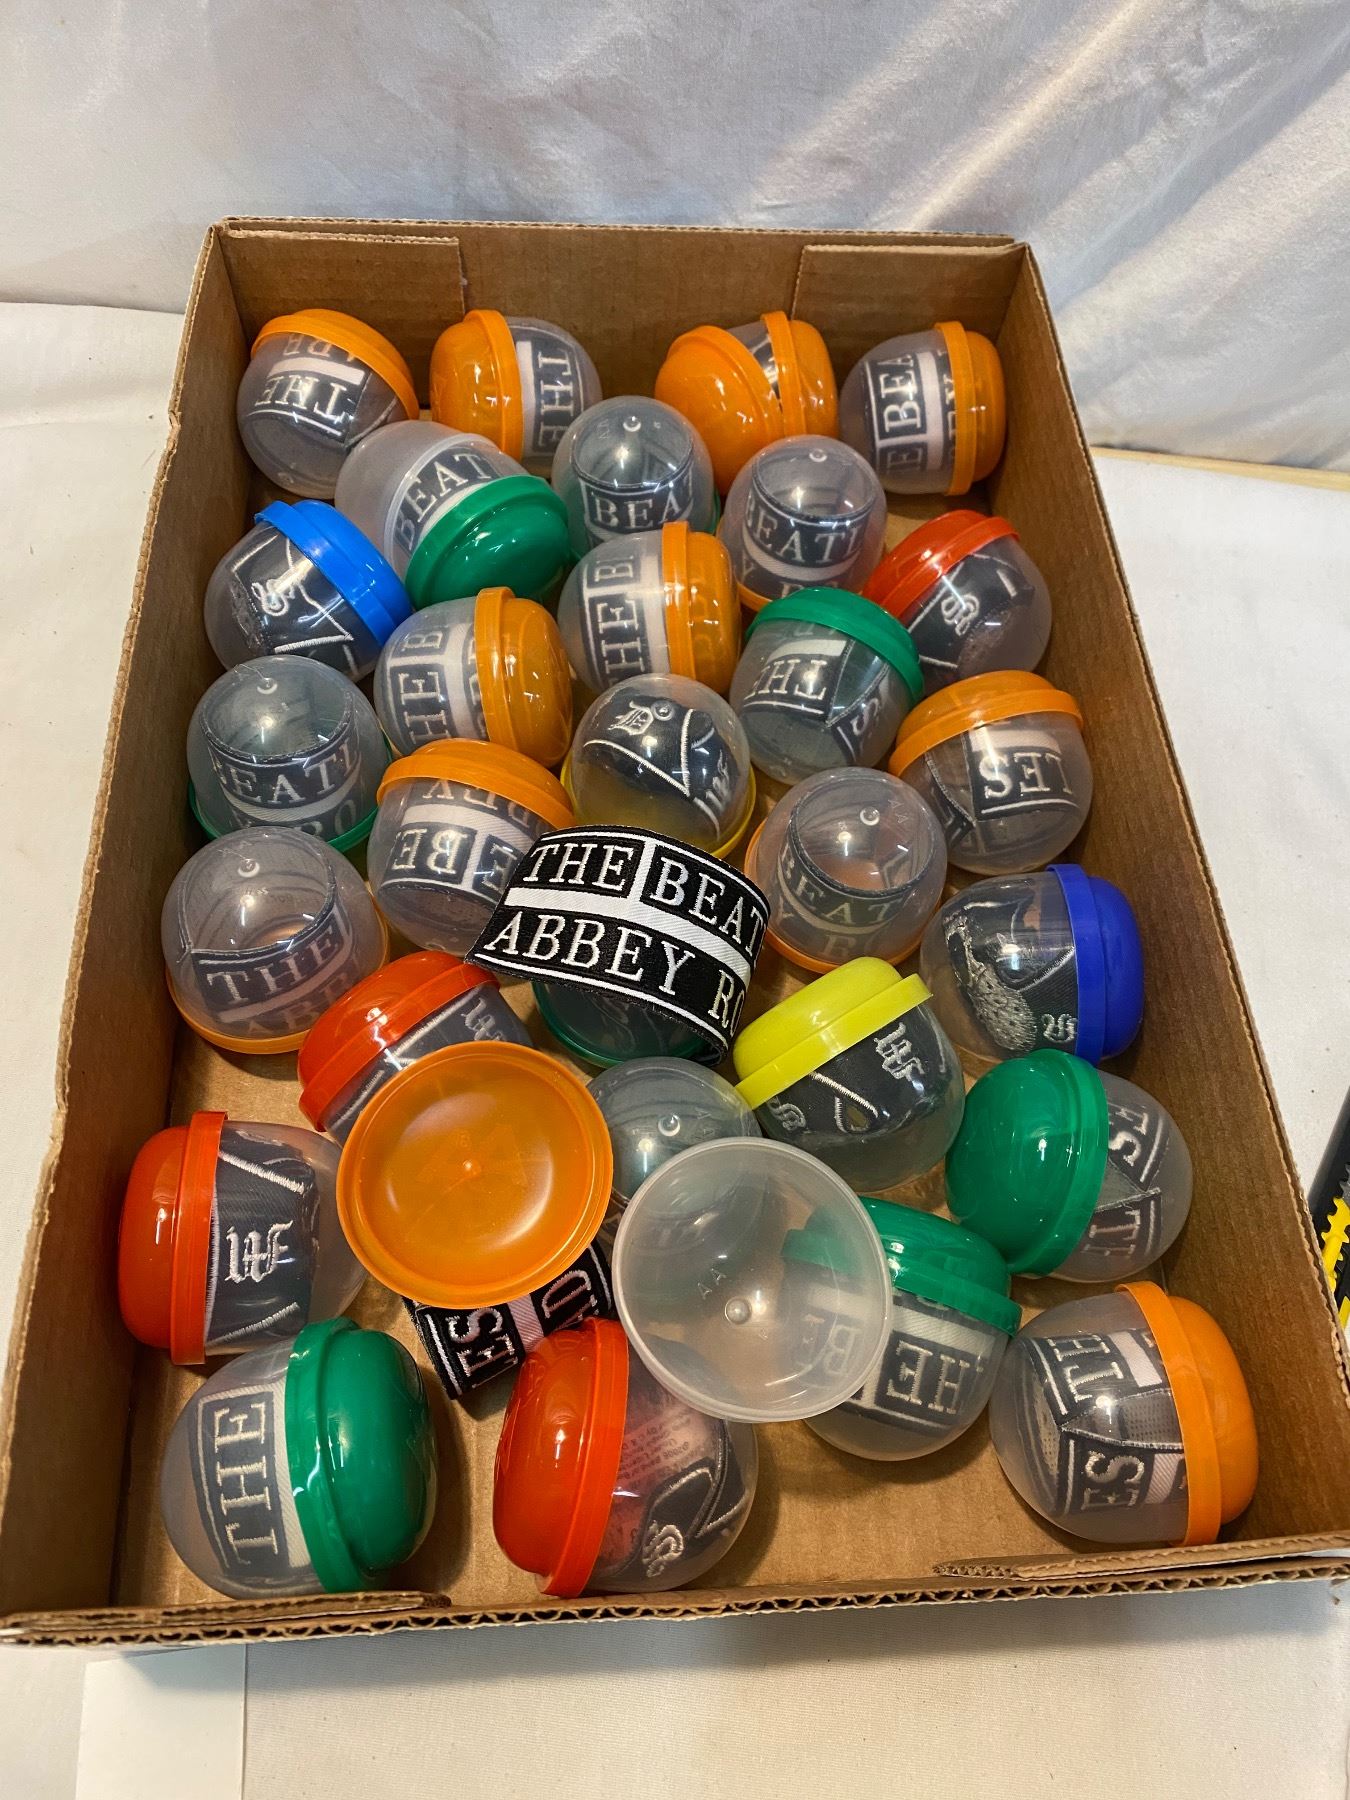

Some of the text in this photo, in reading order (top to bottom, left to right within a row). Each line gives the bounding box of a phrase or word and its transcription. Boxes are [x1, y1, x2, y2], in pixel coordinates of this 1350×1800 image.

[597, 599, 645, 676] HE
[398, 671, 453, 742] HE
[523, 842, 634, 891] THE
[650, 856, 767, 957] BEAT
[206, 925, 338, 1006] THE
[483, 911, 696, 996] ABBEY
[445, 1307, 520, 1388] ES
[887, 1340, 971, 1414] HE
[214, 1402, 279, 1565] THE
